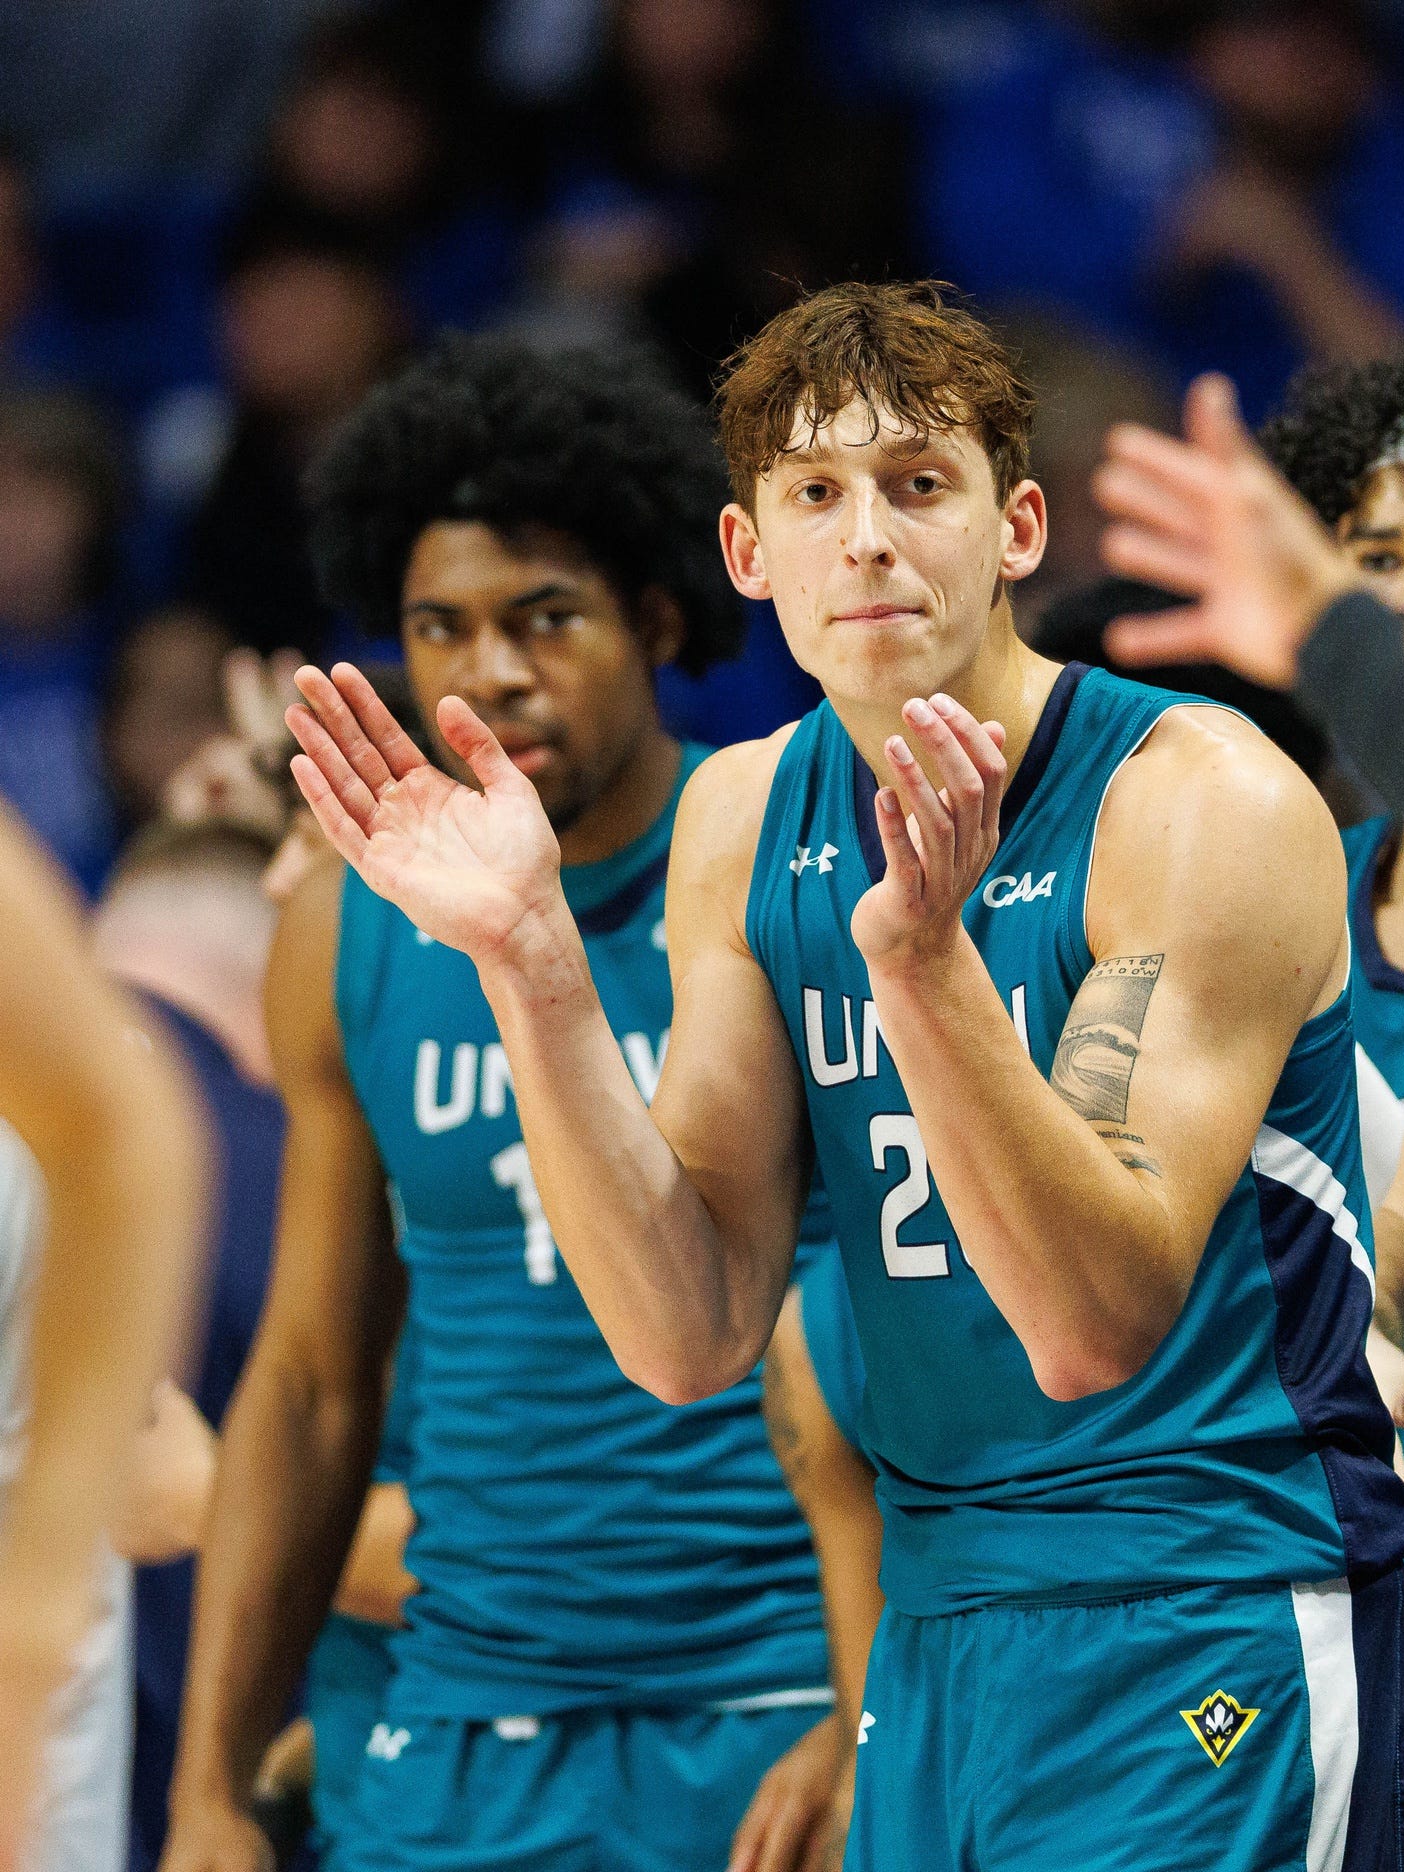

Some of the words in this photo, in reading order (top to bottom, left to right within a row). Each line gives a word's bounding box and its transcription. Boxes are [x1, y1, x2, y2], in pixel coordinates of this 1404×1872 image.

[983, 871, 1058, 909] CAA
[490, 1140, 557, 1285] 1
[867, 1111, 974, 1279] 2
